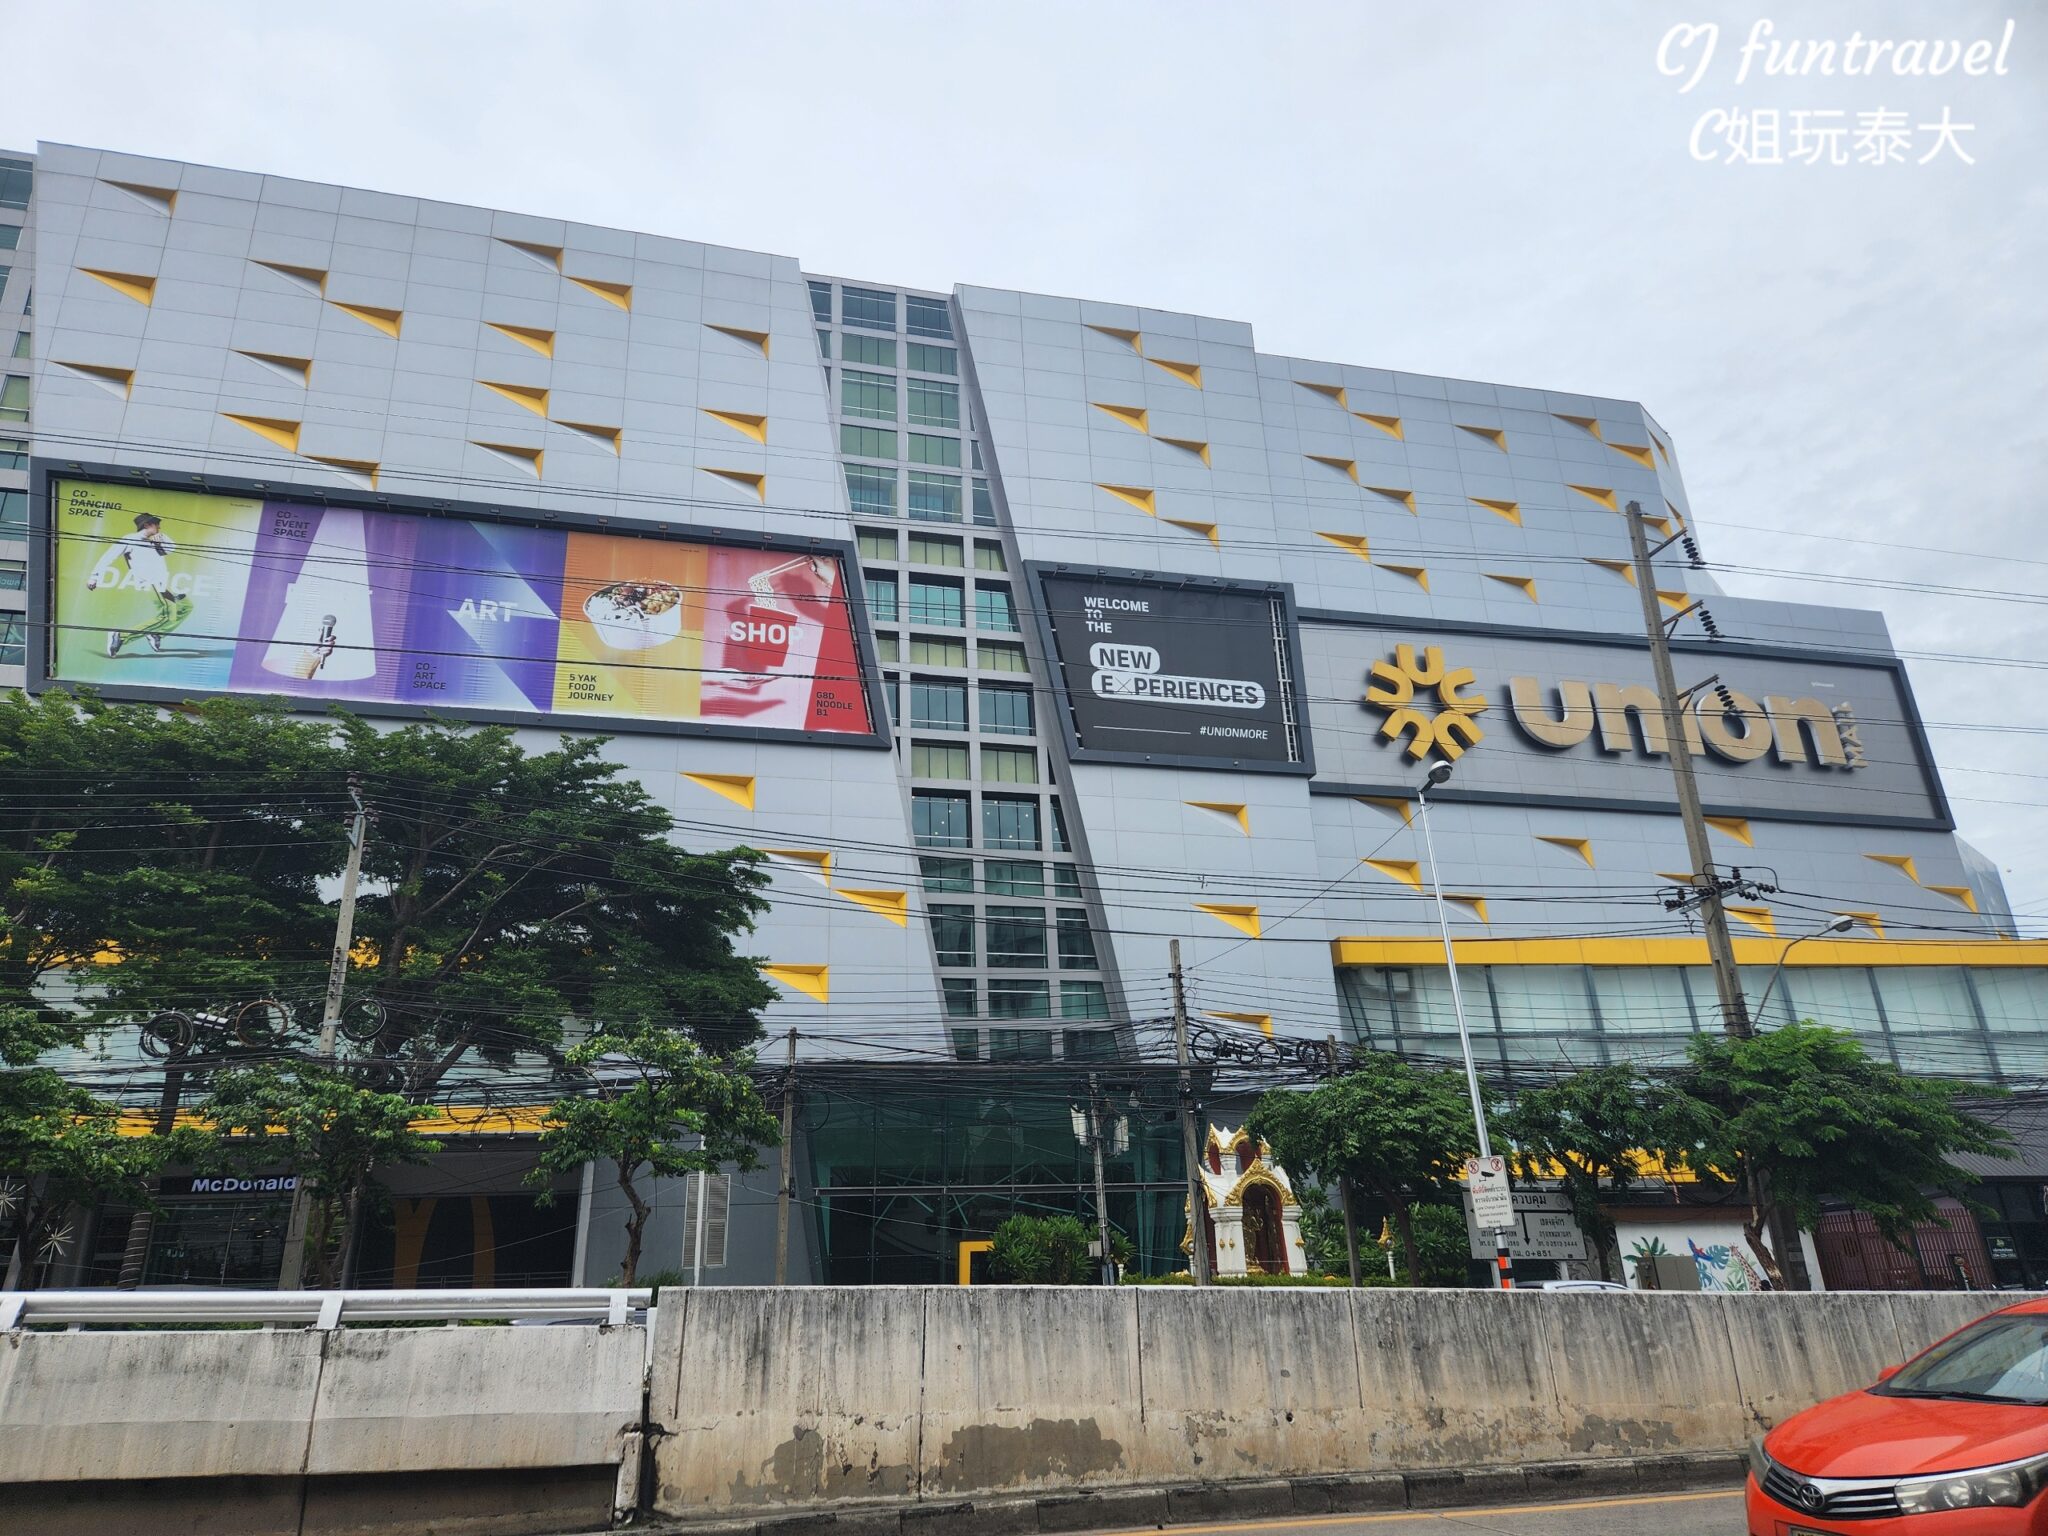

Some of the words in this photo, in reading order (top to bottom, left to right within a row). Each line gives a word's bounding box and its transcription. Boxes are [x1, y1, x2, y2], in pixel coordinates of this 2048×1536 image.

[72, 489, 89, 498] CO
[70, 498, 122, 511] DANCING
[68, 507, 105, 518] SPACE
[276, 510, 291, 519] CO
[275, 519, 311, 530] EVENT
[273, 528, 308, 538] SPACE
[1084, 596, 1150, 613] WELCOME
[458, 598, 518, 623] ART
[1085, 608, 1103, 620] TO
[730, 620, 805, 645] SHOP
[1085, 620, 1113, 634] THE
[1098, 647, 1152, 670] NEW
[416, 662, 430, 671] CO
[414, 672, 435, 680] ART
[569, 673, 576, 681] 5
[578, 674, 597, 682] YAK
[412, 681, 447, 690] SPACE
[568, 682, 596, 691] FOOD
[1101, 674, 1259, 705] EXPERIENCES
[568, 691, 614, 702] JOURNEY
[816, 700, 853, 710] NOODLE
[1199, 725, 1269, 740] #UNIONMORE
